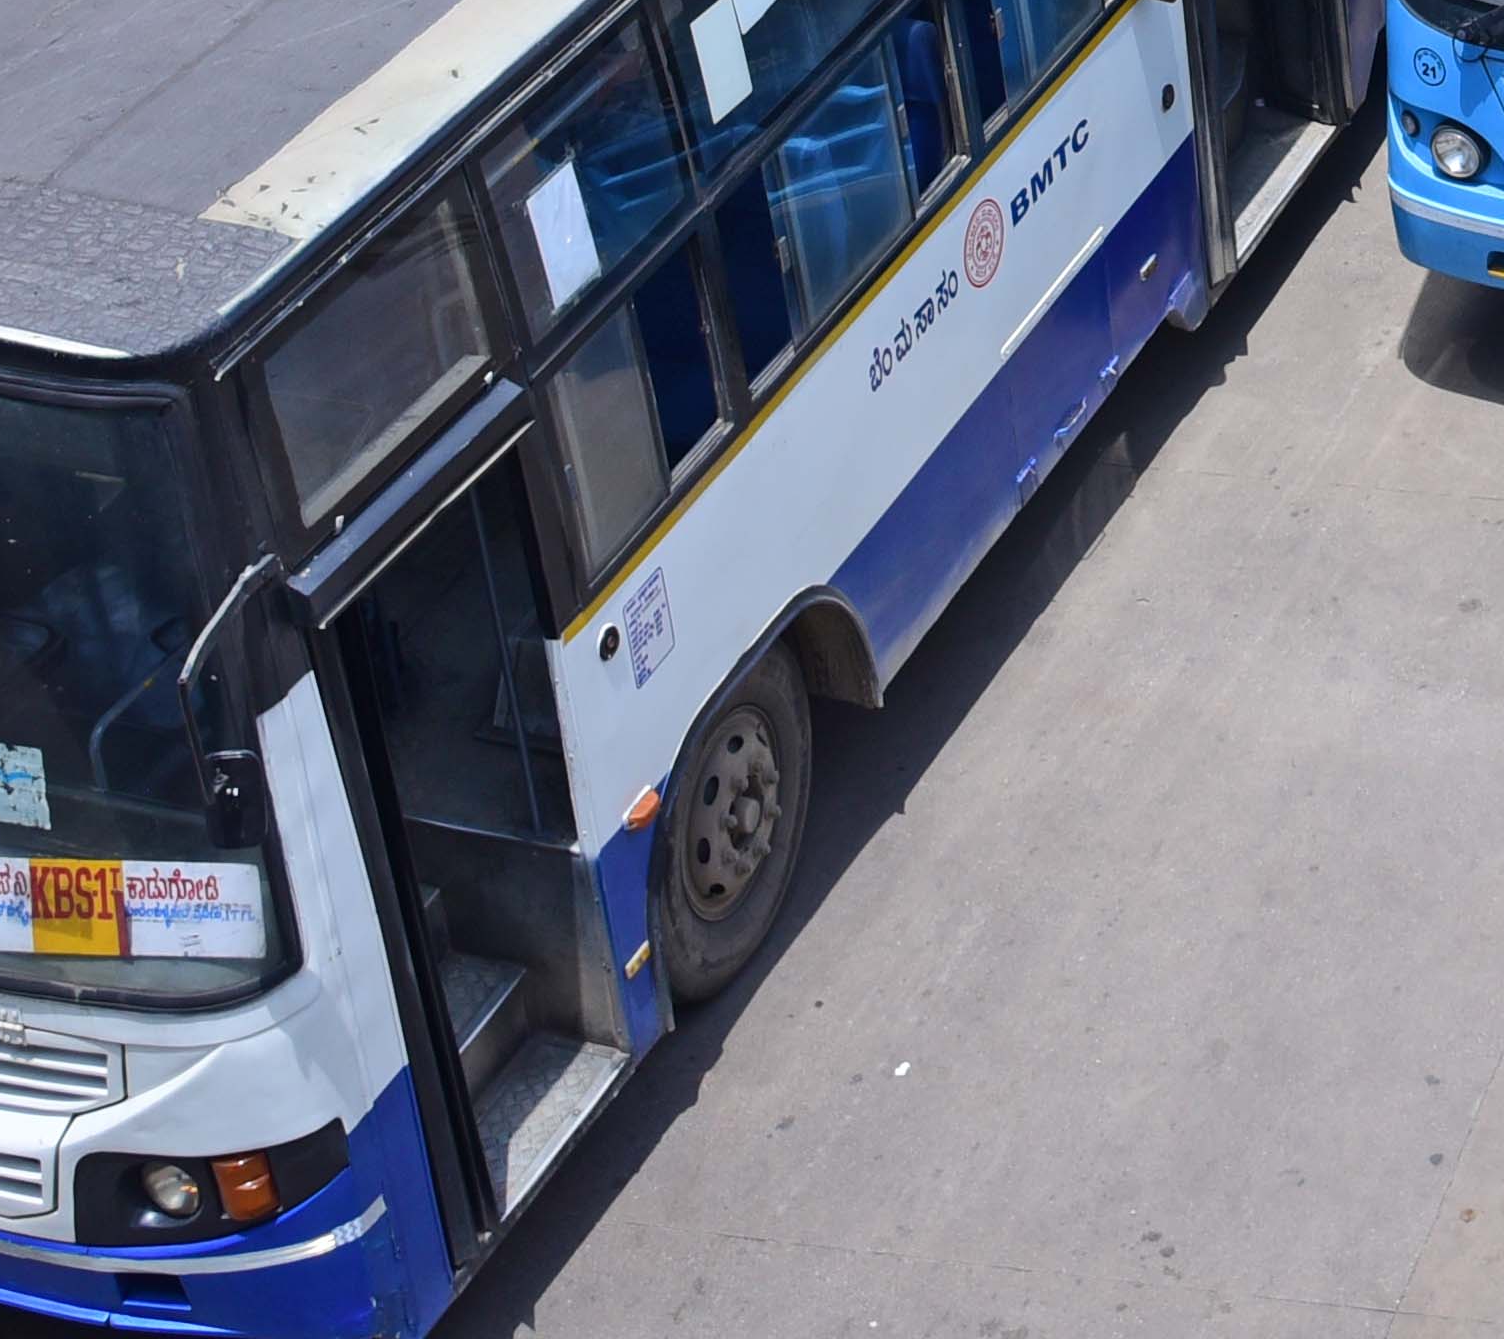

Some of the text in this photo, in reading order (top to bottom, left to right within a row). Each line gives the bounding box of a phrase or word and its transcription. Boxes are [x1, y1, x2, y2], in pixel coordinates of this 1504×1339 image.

[1422, 63, 1437, 80] 21
[1009, 118, 1090, 227] BMTC
[125, 866, 220, 903] ಕಾಡುಗೋಡಿ
